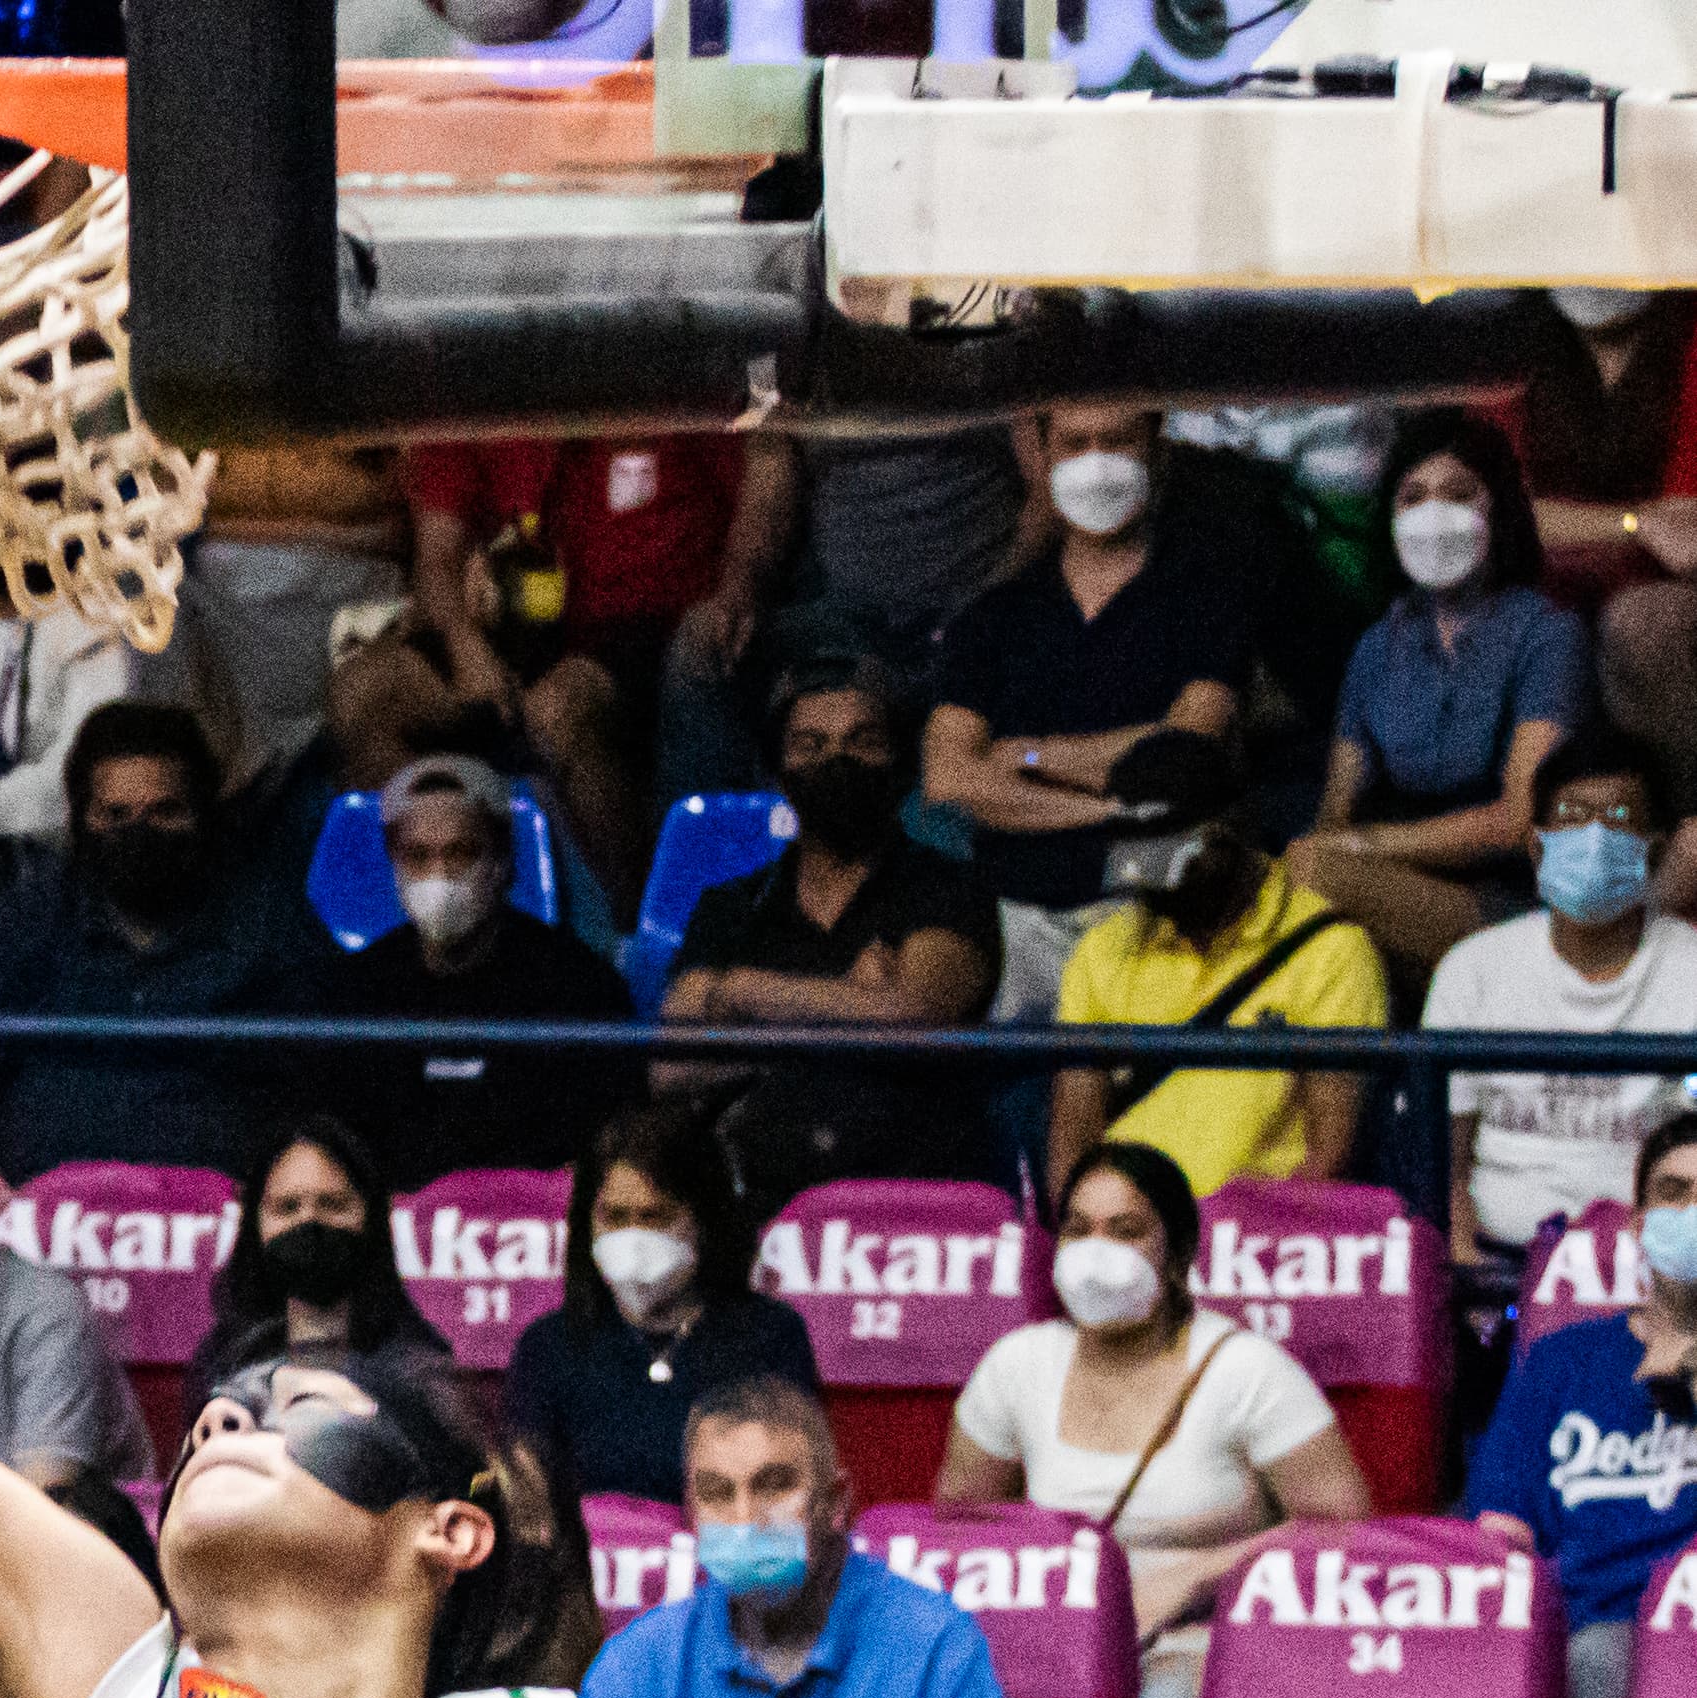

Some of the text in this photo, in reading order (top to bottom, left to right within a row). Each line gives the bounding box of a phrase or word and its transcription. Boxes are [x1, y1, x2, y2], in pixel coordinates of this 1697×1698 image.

[750, 1217, 1023, 1297] Akari
[1187, 1215, 1412, 1298] kari
[1549, 1409, 1697, 1511] Dodg
[853, 1528, 1101, 1611] kari
[1227, 1548, 1536, 1631] Akari
[1347, 1632, 1405, 1675] 34
